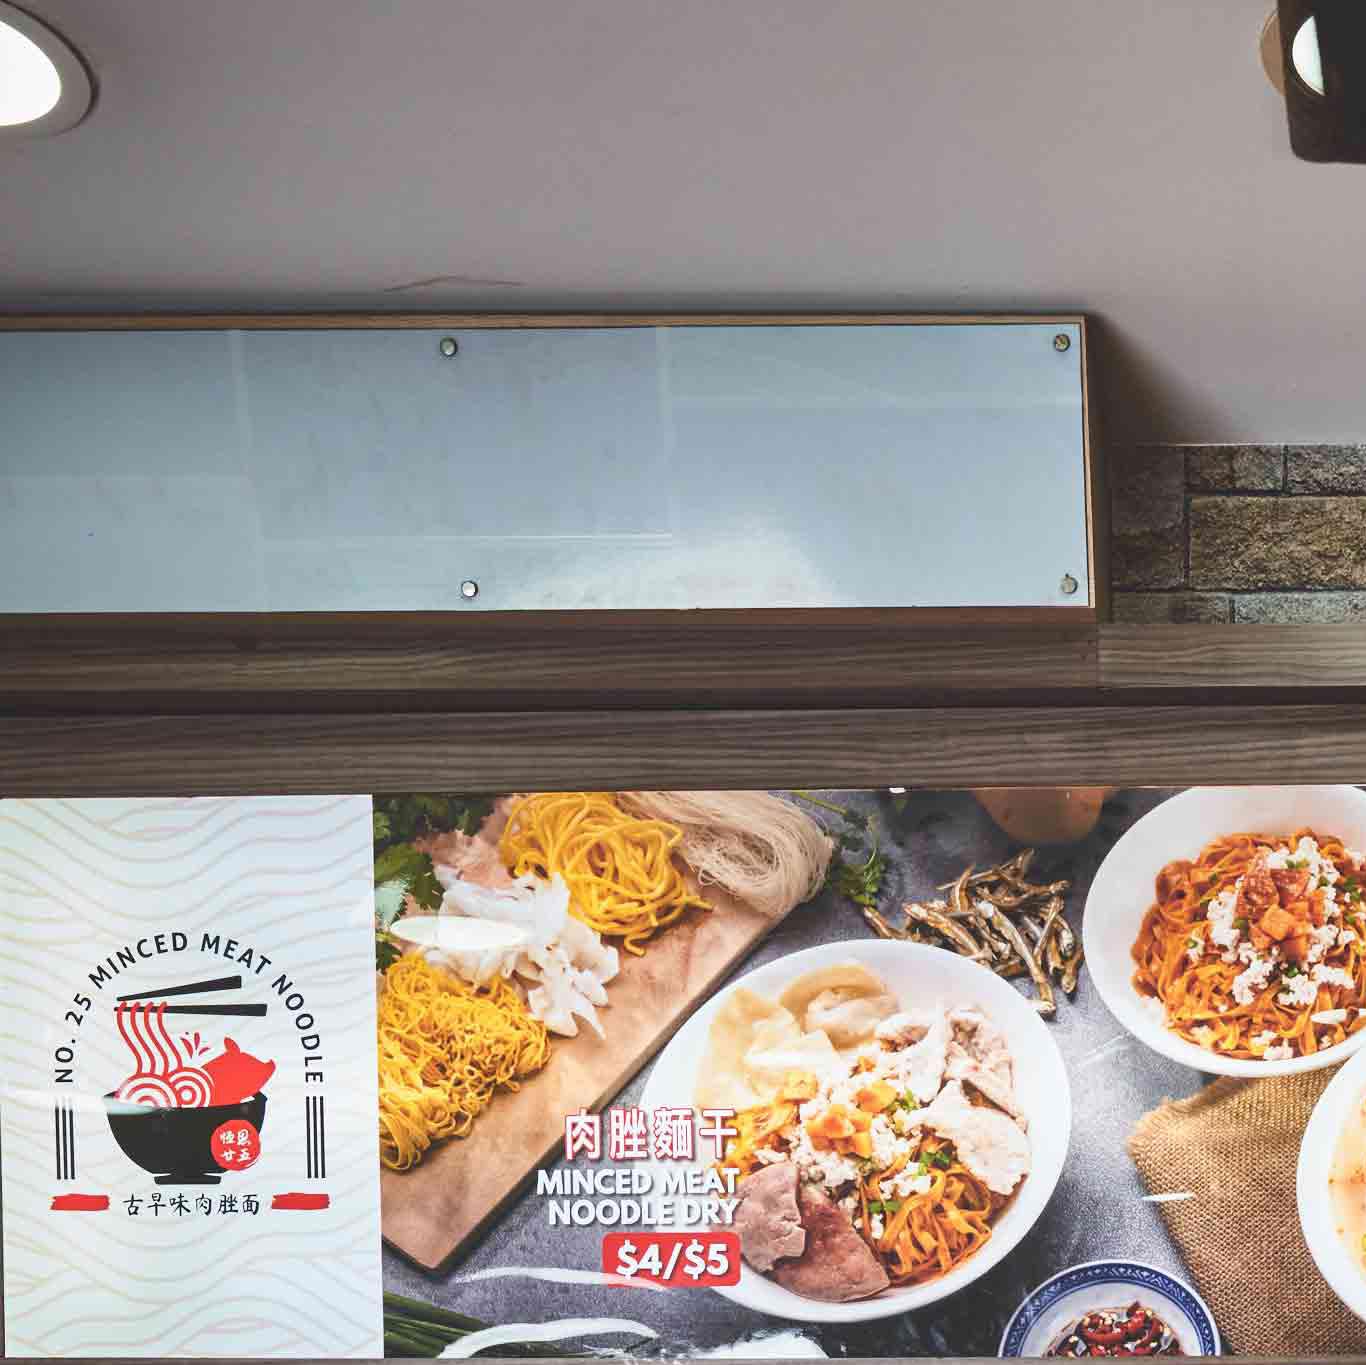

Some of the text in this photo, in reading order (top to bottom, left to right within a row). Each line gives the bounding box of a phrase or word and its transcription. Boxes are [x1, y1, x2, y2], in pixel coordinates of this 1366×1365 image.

[54, 931, 324, 1083] NO. 25 MINCED MEAT NOODLE
[564, 1106, 739, 1162] 肉脞麵干
[537, 1168, 740, 1197] MINCED MEAT
[122, 1192, 261, 1217] 古早味肉脞面
[548, 1199, 740, 1226] NOODLE DRY
[615, 1240, 730, 1280] $4/$5
